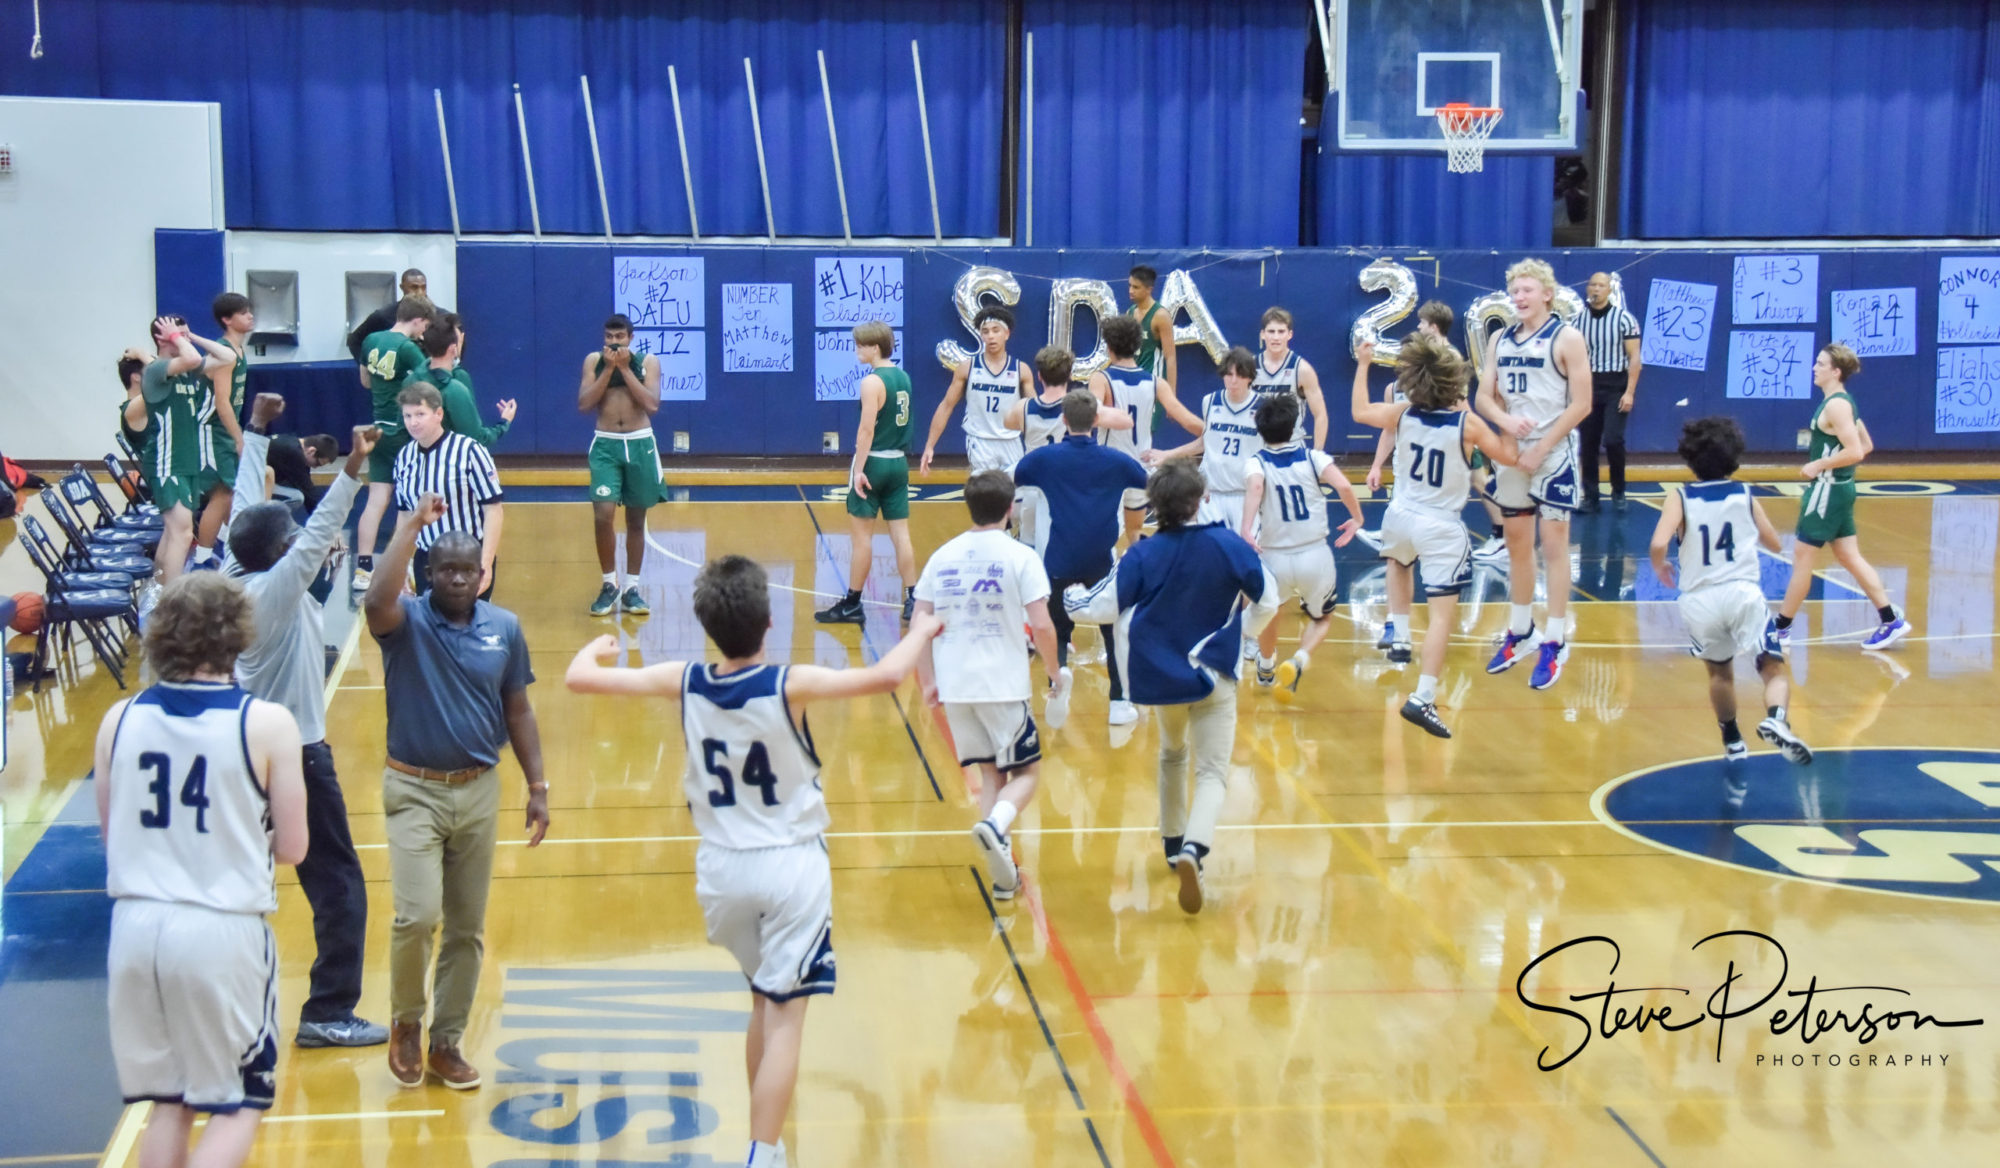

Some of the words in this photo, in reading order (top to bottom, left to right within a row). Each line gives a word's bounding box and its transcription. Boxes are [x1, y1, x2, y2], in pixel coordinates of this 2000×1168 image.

[618, 260, 698, 295] Jackson
[819, 259, 858, 300] #1
[860, 263, 904, 303] Kobe
[1759, 257, 1803, 285] #3
[645, 281, 677, 303] #2
[726, 286, 779, 305] NUMBER
[1964, 297, 1980, 319] 4
[1652, 305, 1706, 341] #23
[1853, 302, 1904, 339] #14
[636, 331, 690, 356] #12
[1742, 346, 1802, 378] #34
[1507, 372, 1527, 394] 30
[1940, 381, 1992, 406] #30
[895, 390, 910, 427] 3
[986, 395, 1001, 413] 12
[1221, 437, 1241, 457] 23
[1409, 441, 1446, 489] 20
[1275, 484, 1311, 523] 10
[1698, 521, 1736, 567] 14
[702, 737, 782, 808] 54
[138, 751, 211, 834] 34
